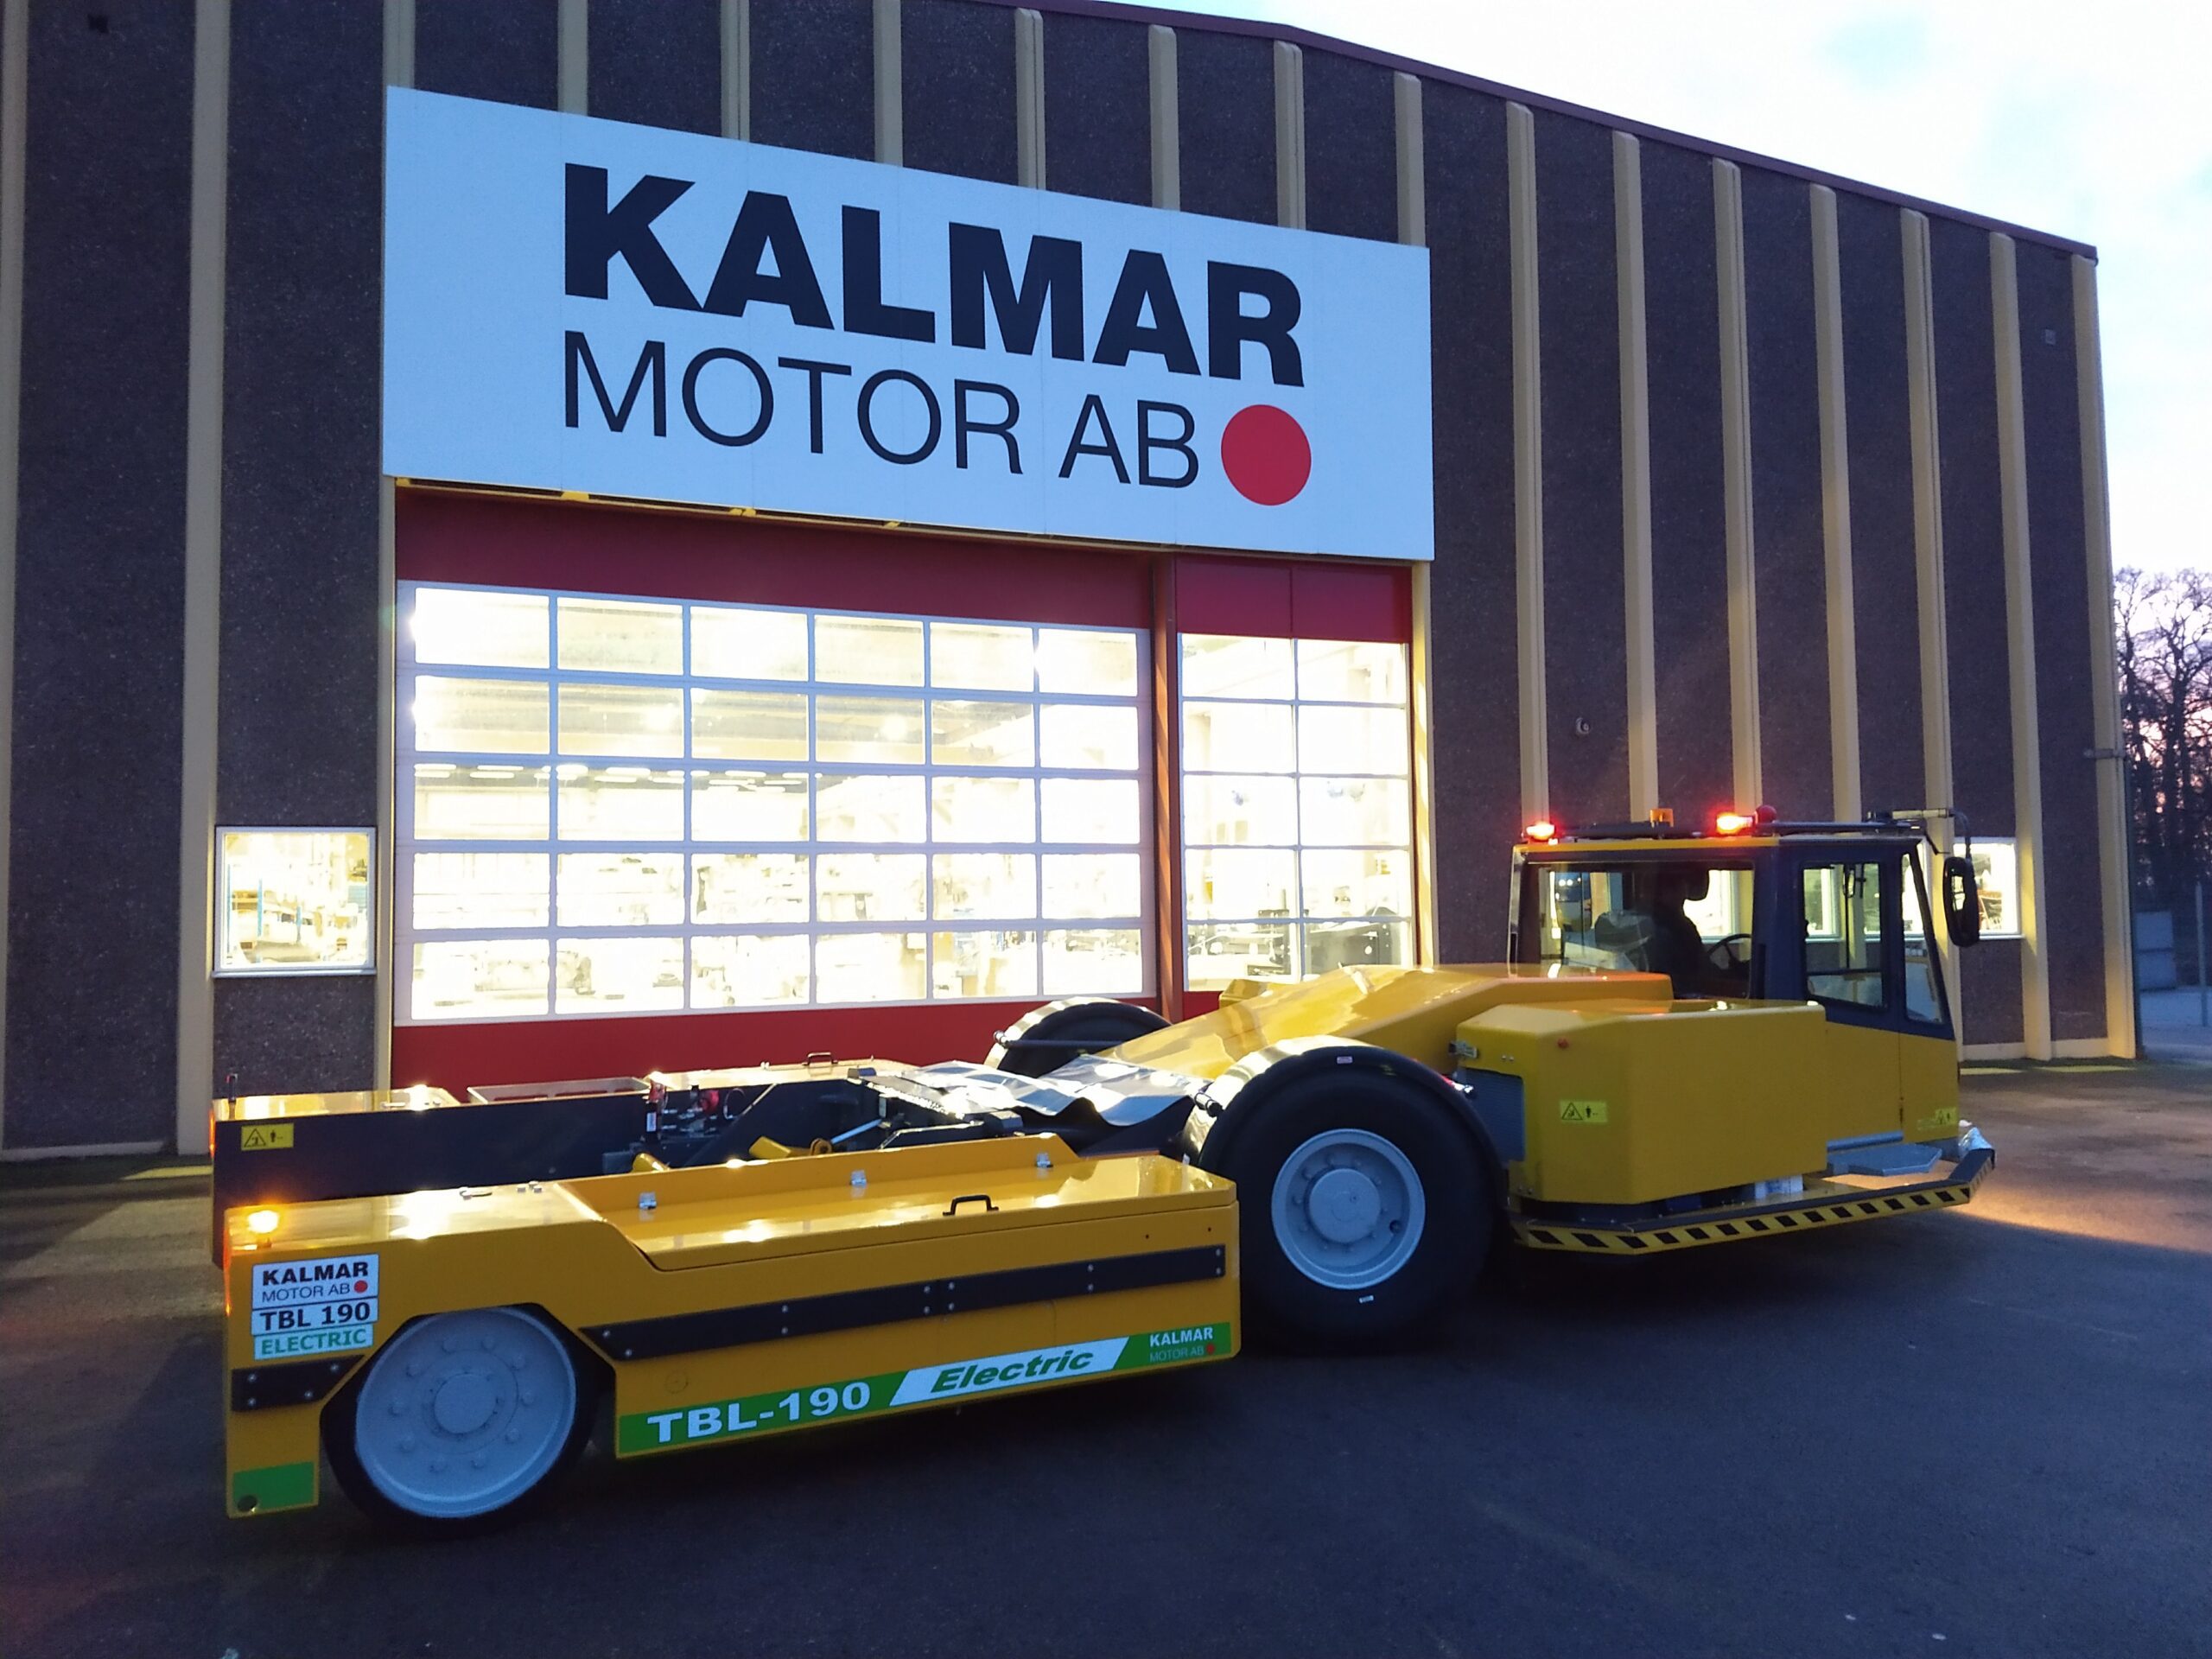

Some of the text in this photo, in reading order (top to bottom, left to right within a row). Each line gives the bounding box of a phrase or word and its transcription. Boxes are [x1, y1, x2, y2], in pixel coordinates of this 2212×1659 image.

[564, 162, 1305, 387] KALMAR
[564, 330, 1200, 488] MOTOR AB
[263, 1262, 369, 1286] KALMAR
[262, 1282, 350, 1302] MOTOR AB
[260, 1302, 371, 1332] TBL 190
[261, 1328, 366, 1355] ELECTRIC
[1149, 1326, 1213, 1347] KALMAR
[1149, 1345, 1205, 1362] MOTOR AB
[646, 1348, 1094, 1444] TBL-190 Electric
